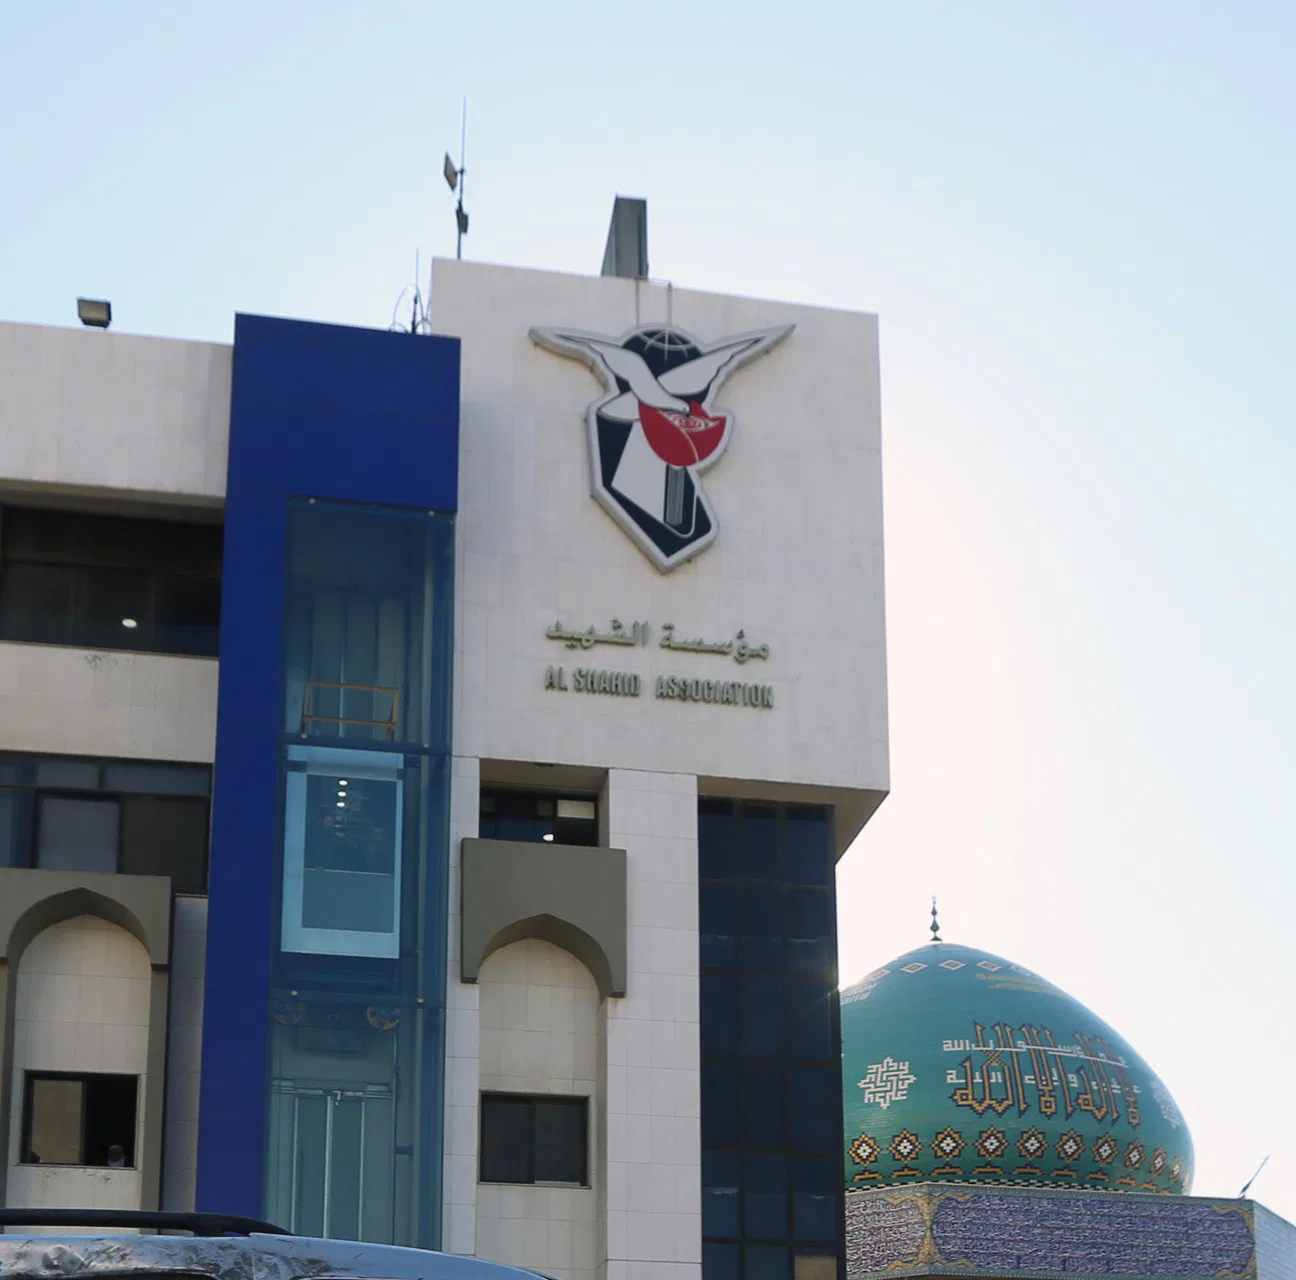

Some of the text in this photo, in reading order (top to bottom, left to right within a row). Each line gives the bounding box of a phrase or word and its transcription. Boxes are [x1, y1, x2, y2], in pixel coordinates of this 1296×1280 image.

[546, 617, 770, 664] مؤسسة الشهيد
[544, 665, 774, 709] AL SHAHID ASSOCIATION
